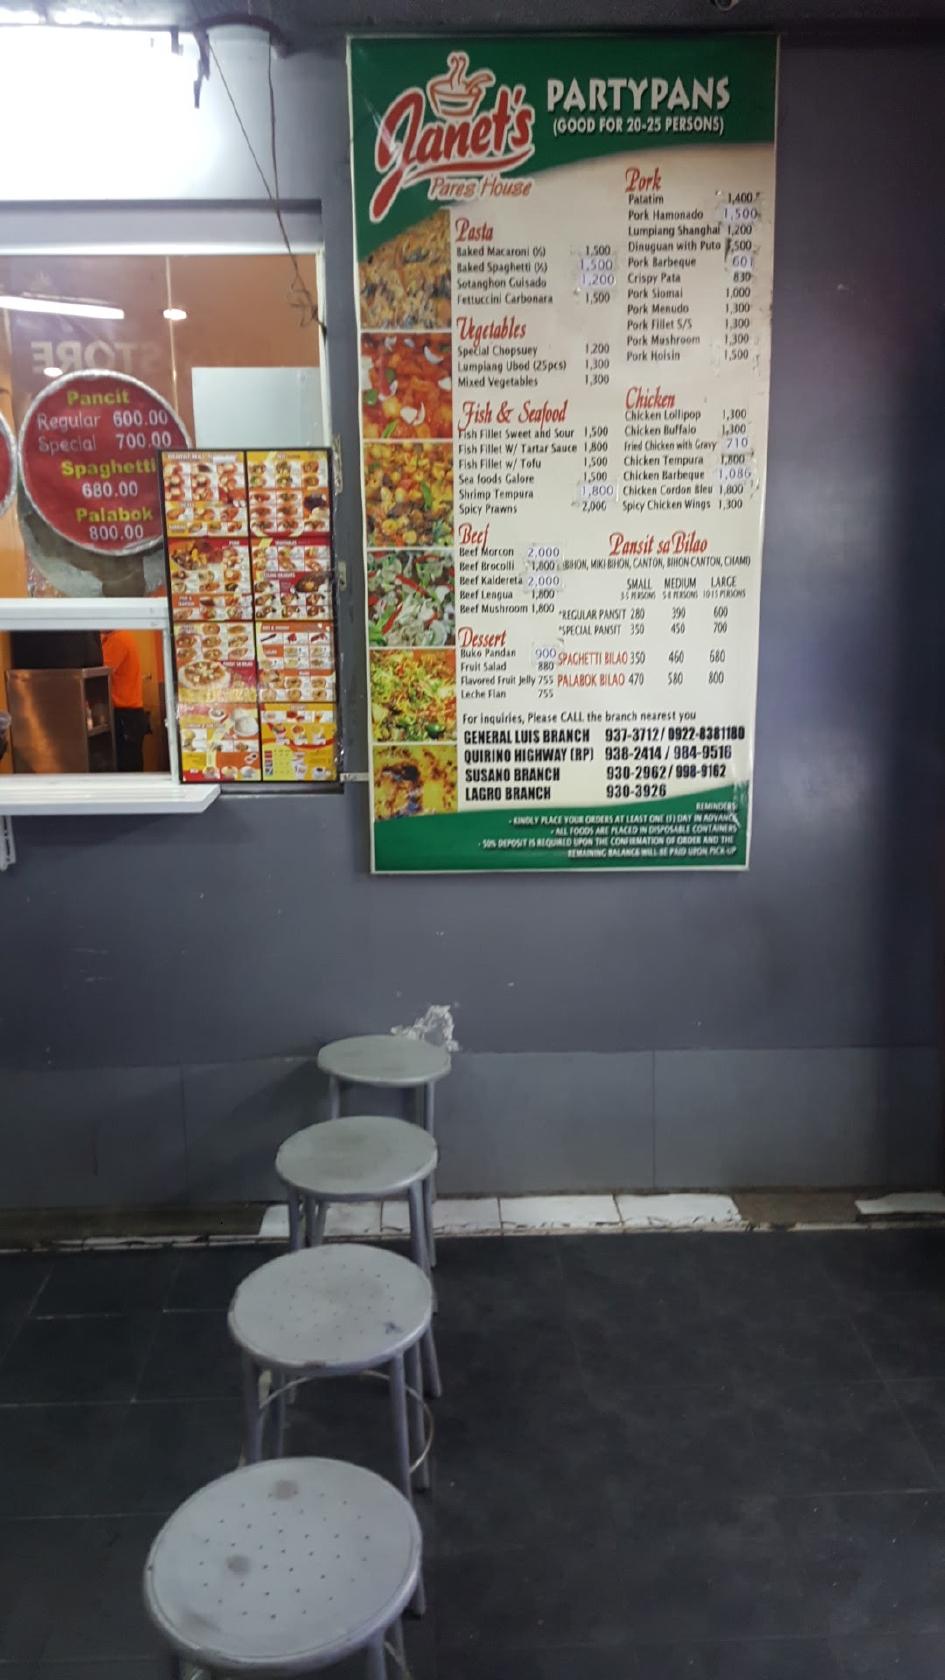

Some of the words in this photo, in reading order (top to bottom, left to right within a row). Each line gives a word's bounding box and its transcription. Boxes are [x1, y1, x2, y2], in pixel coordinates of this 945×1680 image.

[547, 76, 730, 112] PARTYPANS
[553, 117, 595, 136] (GOOD
[600, 117, 622, 132] FOR
[627, 118, 661, 132] 20-25
[665, 116, 724, 136] PERSONS)
[371, 86, 535, 222] Janet's
[625, 166, 662, 192] Pork
[430, 177, 474, 196] Pares
[481, 177, 532, 196] House
[728, 192, 752, 204] 1,400
[628, 209, 649, 220] Pork
[456, 218, 493, 242] Pasta
[628, 226, 675, 237] Lumpiang
[678, 224, 720, 236] Shanghai
[727, 225, 752, 236] 1,200
[457, 247, 483, 256] Baked
[487, 247, 529, 256] Macaroni
[585, 245, 611, 256] 1,500
[676, 239, 697, 250] with
[700, 240, 721, 250] Puto
[457, 262, 484, 273] Baked
[487, 262, 531, 274] Spaghetti
[580, 259, 613, 271] 1,500
[628, 257, 648, 268] Pork
[652, 257, 696, 268] Barbeque
[628, 273, 657, 285] Crispy
[661, 273, 680, 283] Pata
[733, 272, 751, 282] 830
[586, 292, 610, 304] 1,500
[628, 289, 648, 299] Pork
[726, 288, 750, 299] 1,000
[627, 304, 648, 315] Pork
[652, 304, 689, 314] Menudo
[726, 303, 750, 314] 1,300
[456, 315, 527, 348] Vegetables
[627, 335, 648, 346] Pork
[651, 334, 700, 345] Mushroom
[724, 334, 749, 346] 1,300
[458, 346, 489, 358] Special
[493, 346, 538, 358] Chopsuey
[585, 343, 609, 354] 1,200
[458, 361, 502, 373] Lumpiang
[507, 360, 530, 371] Ubod
[533, 360, 566, 372] (25pcs)
[585, 359, 609, 370] 1,300
[458, 376, 485, 387] Mixed
[488, 376, 538, 389] Vegetables
[585, 374, 609, 386] 1,300
[67, 389, 130, 406] Pancit
[625, 386, 676, 409] Chicken
[37, 411, 100, 432] Regular
[113, 409, 168, 427] 600.00
[458, 400, 492, 432] Fish
[497, 400, 514, 424] &
[518, 399, 568, 431] Seafood
[625, 410, 661, 422] Chicken
[664, 409, 701, 421] Lollipop
[723, 409, 746, 421] 1,300
[505, 428, 531, 439] Sweet
[535, 428, 551, 438] and
[554, 428, 574, 438] Sour
[584, 426, 608, 438] 1,500
[624, 425, 660, 436] Chicken
[38, 434, 96, 456] Special
[116, 431, 172, 449] 700.00
[624, 455, 660, 467] Chicken
[663, 455, 703, 466] Tempura
[721, 454, 745, 466] 1,800
[61, 458, 156, 479] Spaghetti
[623, 470, 659, 481] Chicken
[662, 470, 704, 480] Barbeque
[583, 472, 607, 483] 1,500
[82, 481, 138, 499] 680.00
[459, 489, 491, 500] Shrimp
[494, 489, 534, 500] Tempura
[583, 485, 613, 497] 1,800
[623, 485, 656, 496] Chicken
[459, 504, 482, 516] Spicy
[486, 504, 517, 514] Prawns
[582, 501, 606, 513] 2,000
[622, 500, 645, 512] Spicy
[647, 500, 682, 510] Chicken
[684, 499, 711, 510] Wings
[719, 499, 743, 510] 1,300
[75, 507, 153, 522] Palabok
[89, 525, 144, 540] 800.00
[458, 523, 489, 551] Beef
[609, 532, 654, 556] Pansit
[671, 530, 708, 554] Bilao
[459, 547, 478, 557] Beef
[481, 548, 514, 557] Morcon
[528, 547, 559, 558] 2,000
[459, 576, 478, 585] Beef
[627, 578, 652, 590] SMALL
[664, 577, 696, 588] MEDIUM
[711, 576, 736, 587] LARGE
[459, 591, 478, 599] Beef
[481, 591, 513, 601] Lengua
[532, 590, 555, 600] 1,800
[460, 604, 478, 613] Beef
[481, 604, 528, 613] Mushroom
[532, 603, 554, 614] 1,800
[599, 608, 626, 620] PANSIT
[630, 608, 645, 620] 280
[672, 607, 685, 620] 390
[713, 606, 728, 618] 600
[594, 624, 621, 635] PANSIT
[630, 624, 645, 635] 350
[671, 623, 685, 634] 450
[713, 622, 727, 634] 700
[458, 627, 506, 648] Dessert
[461, 648, 481, 658] Buko
[485, 647, 516, 657] Pandan
[605, 652, 628, 665] BILAO
[630, 651, 645, 665] 350
[668, 650, 684, 663] 460
[484, 661, 507, 671] Salad
[557, 673, 597, 688] PALABOK
[599, 673, 625, 687] BILAO
[628, 673, 644, 686] 470
[668, 672, 683, 686] 580
[708, 671, 724, 684] 800
[461, 689, 486, 699] Leche
[463, 714, 477, 724] For
[528, 712, 557, 723] Please
[560, 712, 584, 722] CALL
[587, 711, 602, 722] the
[605, 710, 637, 722] branch
[640, 710, 676, 721] nearest
[679, 711, 697, 723] you
[464, 730, 512, 744] GENERAL
[515, 730, 540, 743] LUIS
[543, 729, 590, 743] BRANCH
[465, 749, 511, 764] QUIRINO
[514, 748, 567, 762] HIGHWAY
[465, 768, 511, 782] SUSANO
[514, 767, 560, 781] BRANCH
[466, 787, 501, 801] LAGRO
[505, 787, 551, 800] BRANCH
